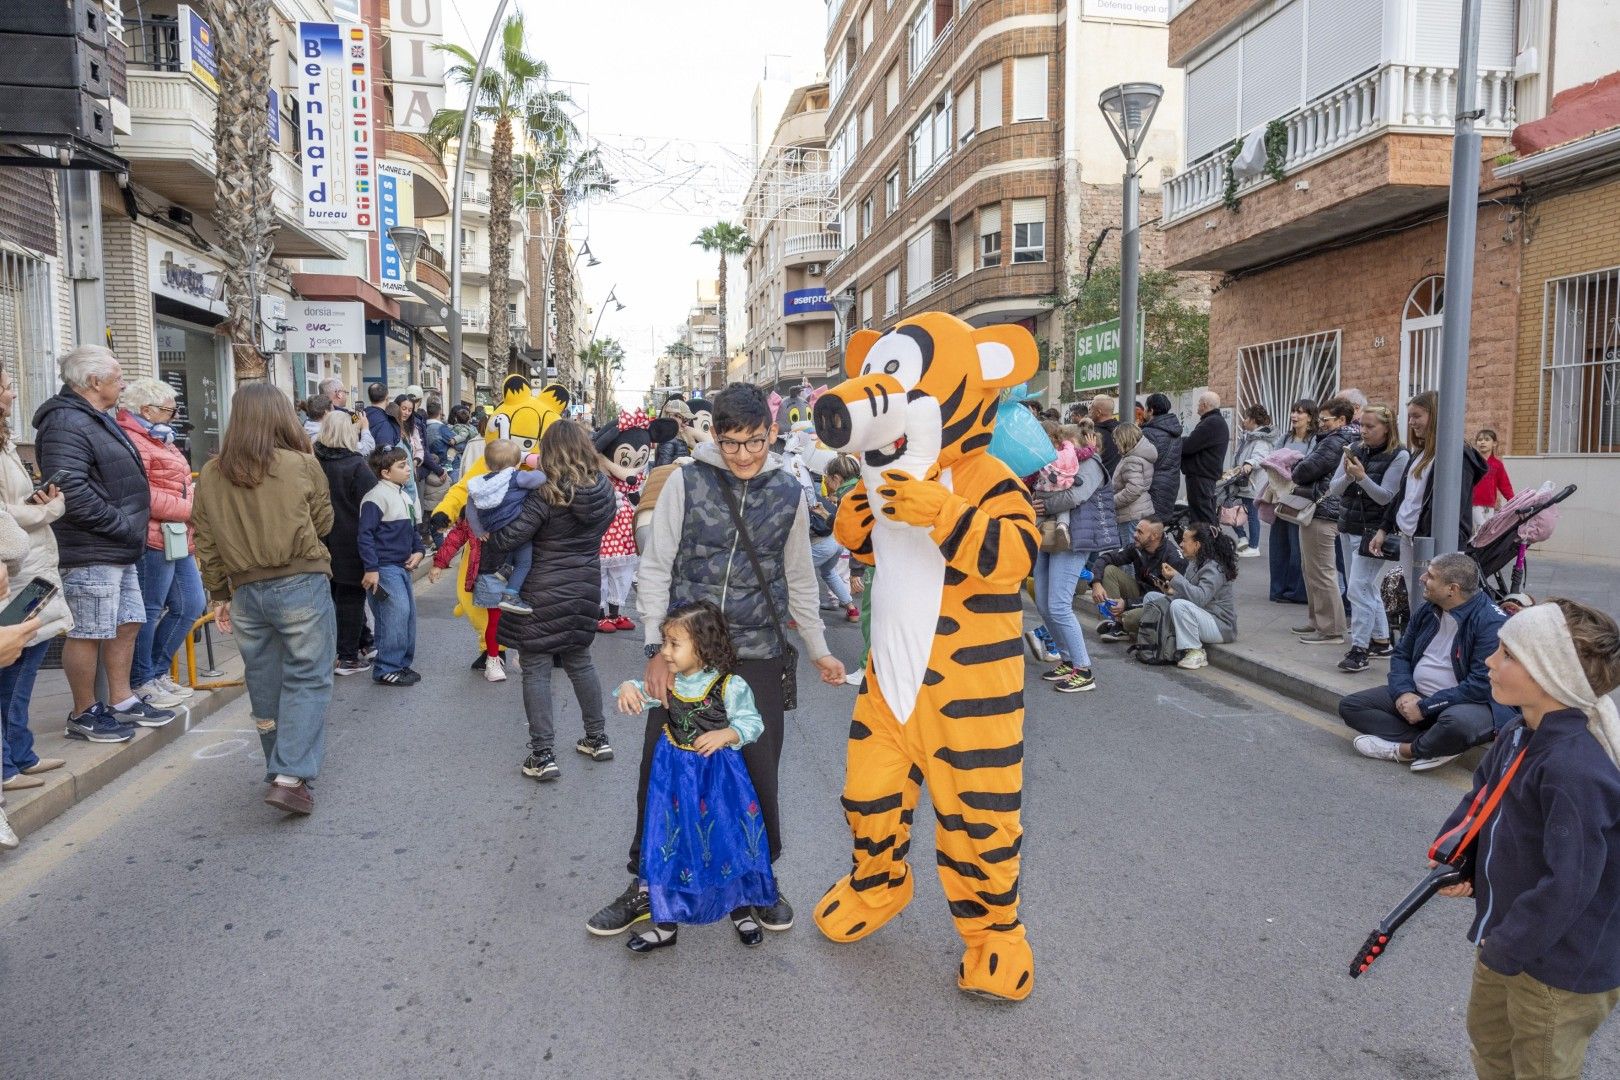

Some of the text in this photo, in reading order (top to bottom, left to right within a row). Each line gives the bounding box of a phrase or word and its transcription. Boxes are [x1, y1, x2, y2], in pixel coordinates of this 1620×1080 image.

[1097, 0, 1132, 10] Defensa
[1134, 3, 1156, 13] legal
[304, 38, 327, 203] Bernhard
[378, 163, 412, 177] MANRESA
[309, 207, 348, 219] bureau
[383, 180, 397, 278] aseores
[304, 305, 332, 317] dorsia
[306, 322, 330, 331] eva
[316, 337, 342, 346] origen
[1078, 335, 1093, 357] SE
[1087, 359, 1118, 381] 649 069
